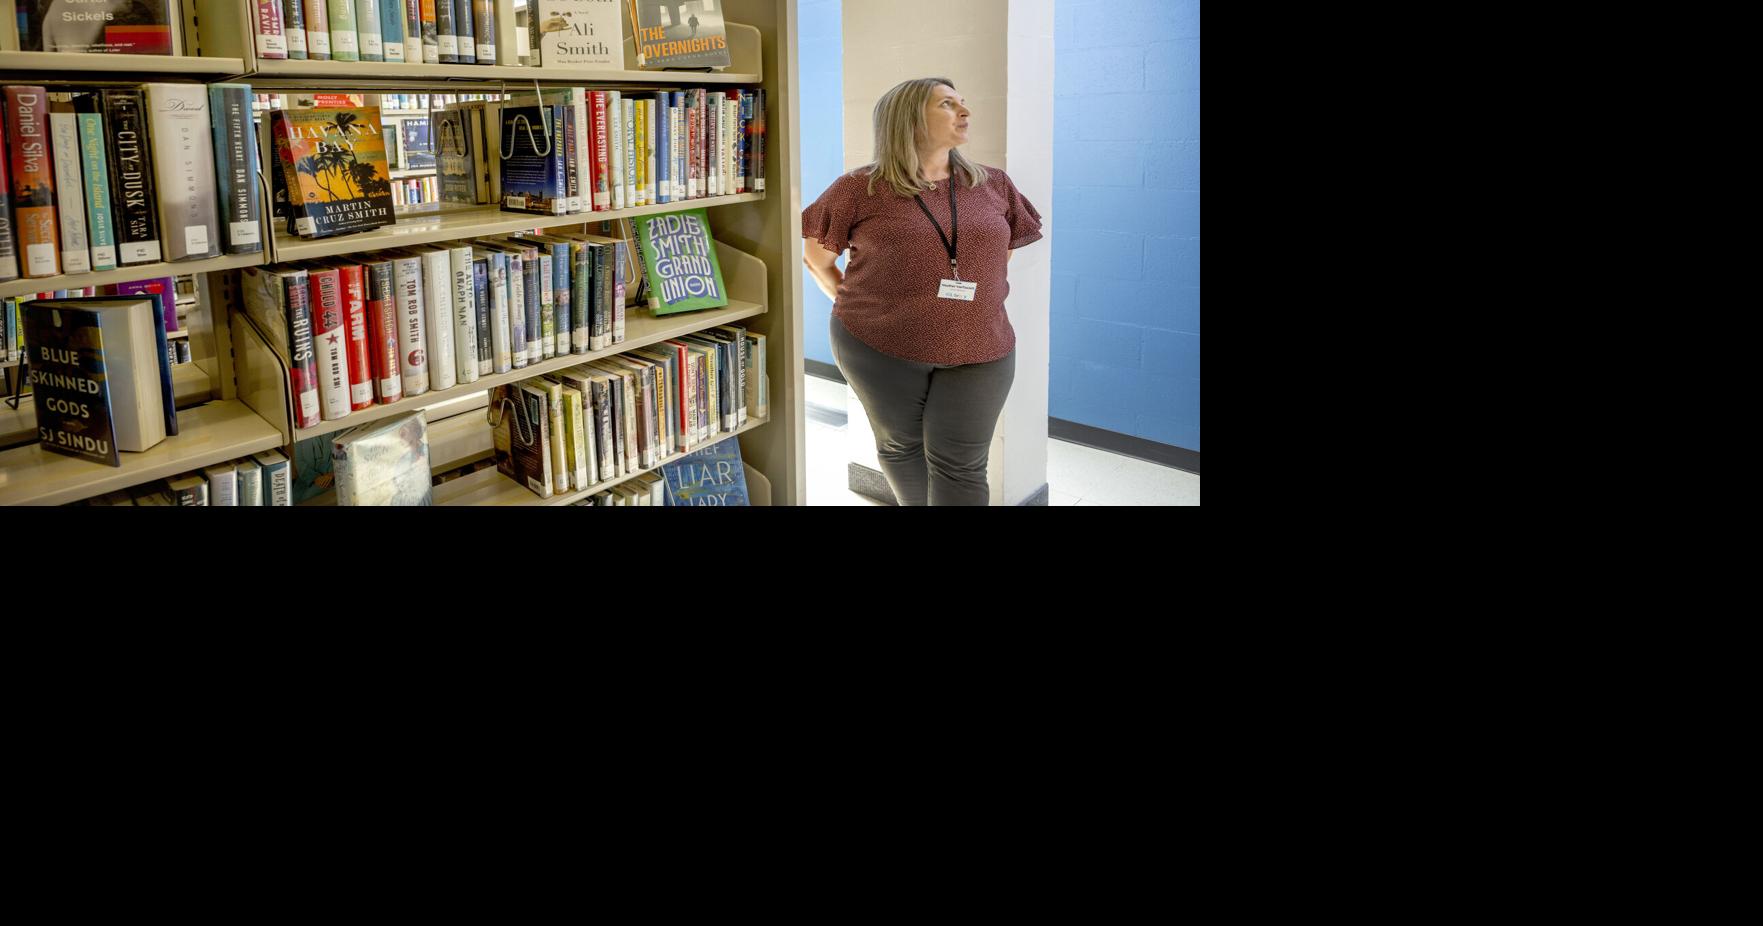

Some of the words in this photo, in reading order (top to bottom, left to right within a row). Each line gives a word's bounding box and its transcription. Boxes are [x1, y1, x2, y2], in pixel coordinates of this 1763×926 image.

[61, 11, 114, 22] Sickels
[570, 22, 594, 37] Ali
[640, 25, 665, 42] THE
[556, 41, 609, 56] Smith
[643, 34, 727, 60] OVERNIGHTS
[231, 103, 240, 115] THE
[595, 93, 605, 108] THE
[17, 94, 42, 137] Daniel
[181, 127, 191, 150] DAN
[232, 118, 242, 138] FIFTH
[288, 120, 378, 140] HAVANA
[595, 110, 607, 162] EVERLASTING
[117, 131, 140, 163] CITY
[234, 141, 244, 162] HEART
[315, 137, 358, 154] BAY
[22, 142, 43, 173] Silva
[235, 168, 247, 184] DAN
[93, 184, 105, 209] Island
[122, 172, 145, 208] DUSK
[185, 160, 199, 218] SIMMONS
[237, 188, 250, 223] SIMMONS
[315, 213, 345, 225] CRUZ
[348, 207, 388, 221] SMITH
[325, 200, 372, 214] MARTIN
[129, 219, 140, 236] SIM
[138, 215, 148, 238] TARA
[646, 214, 700, 241] ZADIE
[650, 235, 707, 260] SMITH
[464, 251, 472, 271] THE
[655, 255, 712, 279] GRAND
[319, 276, 336, 308] CHILD
[406, 279, 417, 296] TOM
[455, 271, 466, 303] GRAPH
[660, 275, 718, 303] UNION
[295, 308, 304, 320] THE
[348, 288, 366, 342] FARM
[407, 299, 418, 314] ROB
[457, 306, 467, 327] MAN
[322, 310, 338, 329] 44
[293, 318, 313, 362] RUINS
[408, 318, 420, 344] SMITH
[40, 346, 80, 366] BLUE
[330, 347, 338, 360] TOM
[331, 363, 340, 375] ROB
[31, 369, 100, 395] SKINNED
[46, 397, 90, 419] GODS
[39, 426, 54, 442] SJ
[58, 430, 109, 455] SINDU
[272, 472, 287, 495] DEATH
[677, 461, 733, 490] LIAR
